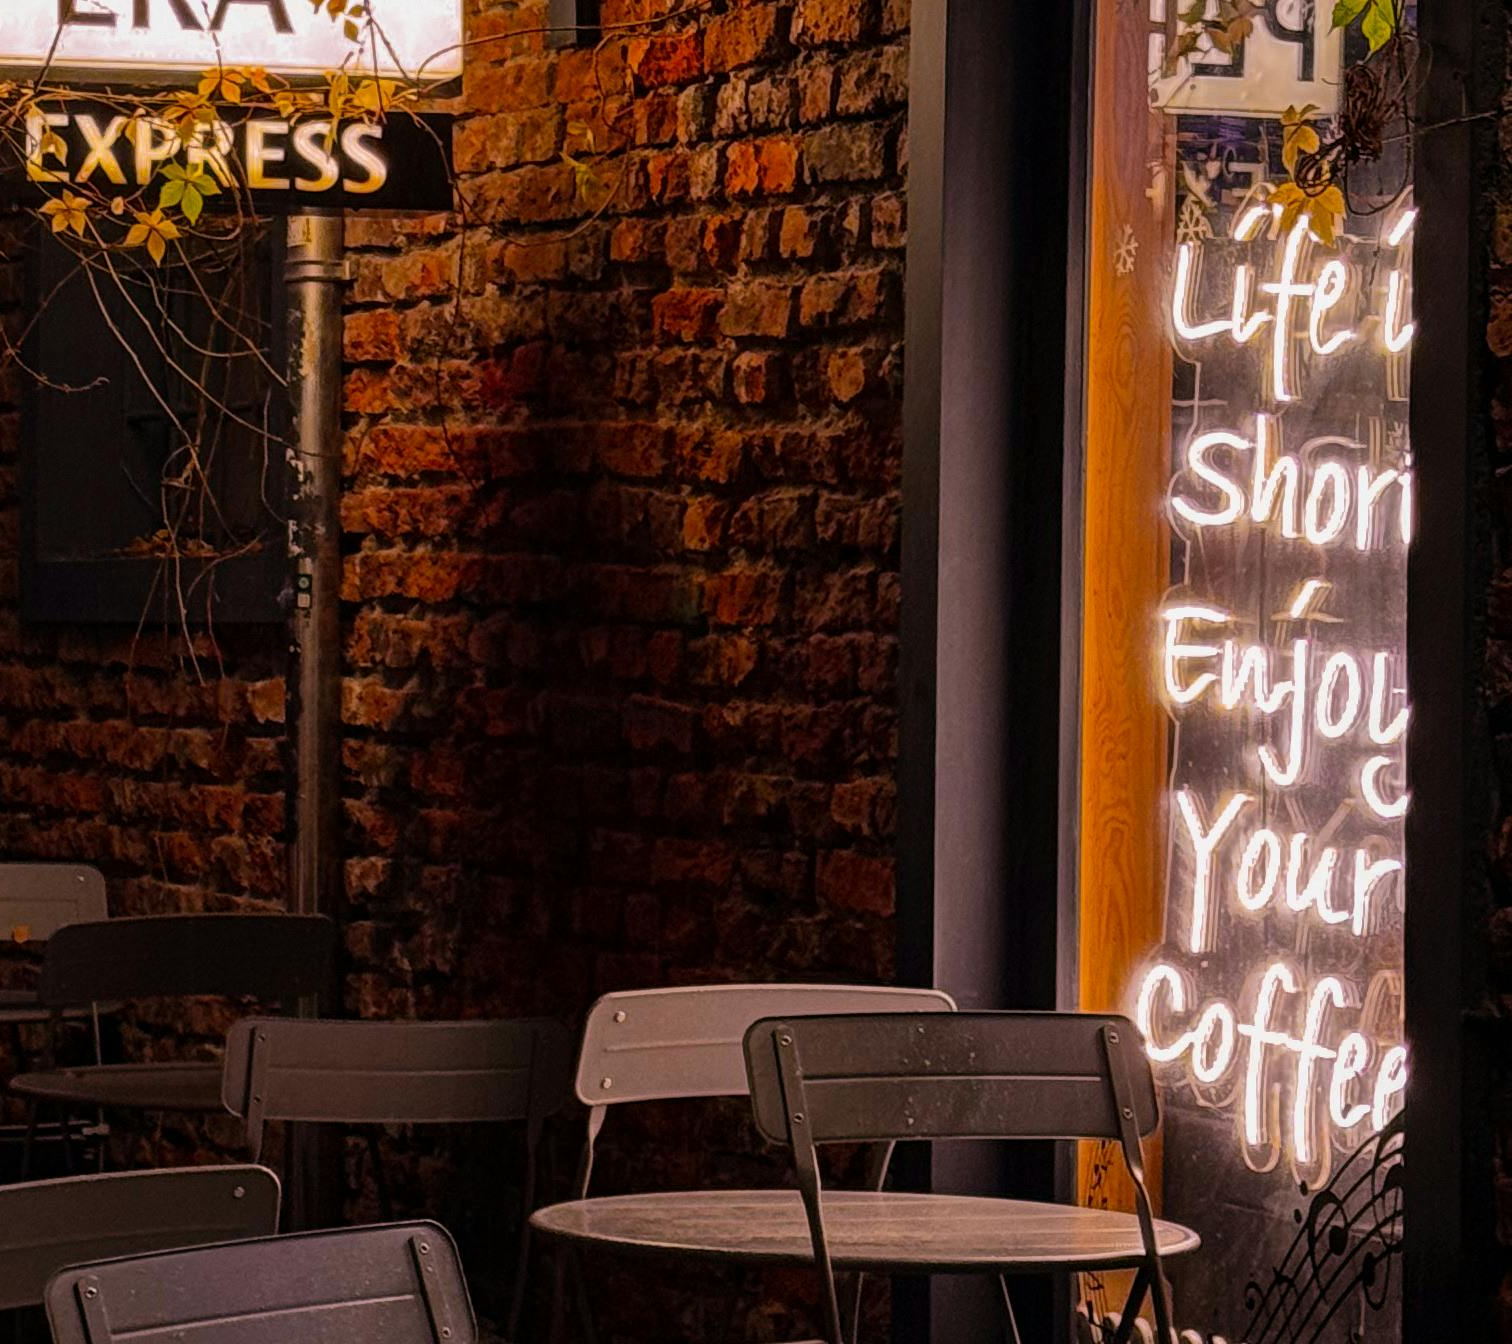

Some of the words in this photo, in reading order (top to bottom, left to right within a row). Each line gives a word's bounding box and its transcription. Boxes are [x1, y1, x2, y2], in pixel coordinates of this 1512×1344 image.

[26, 112, 389, 194] EXPRESS
[1173, 202, 1358, 402] Life
[1384, 206, 1419, 354] i
[1176, 789, 1404, 954] Your
